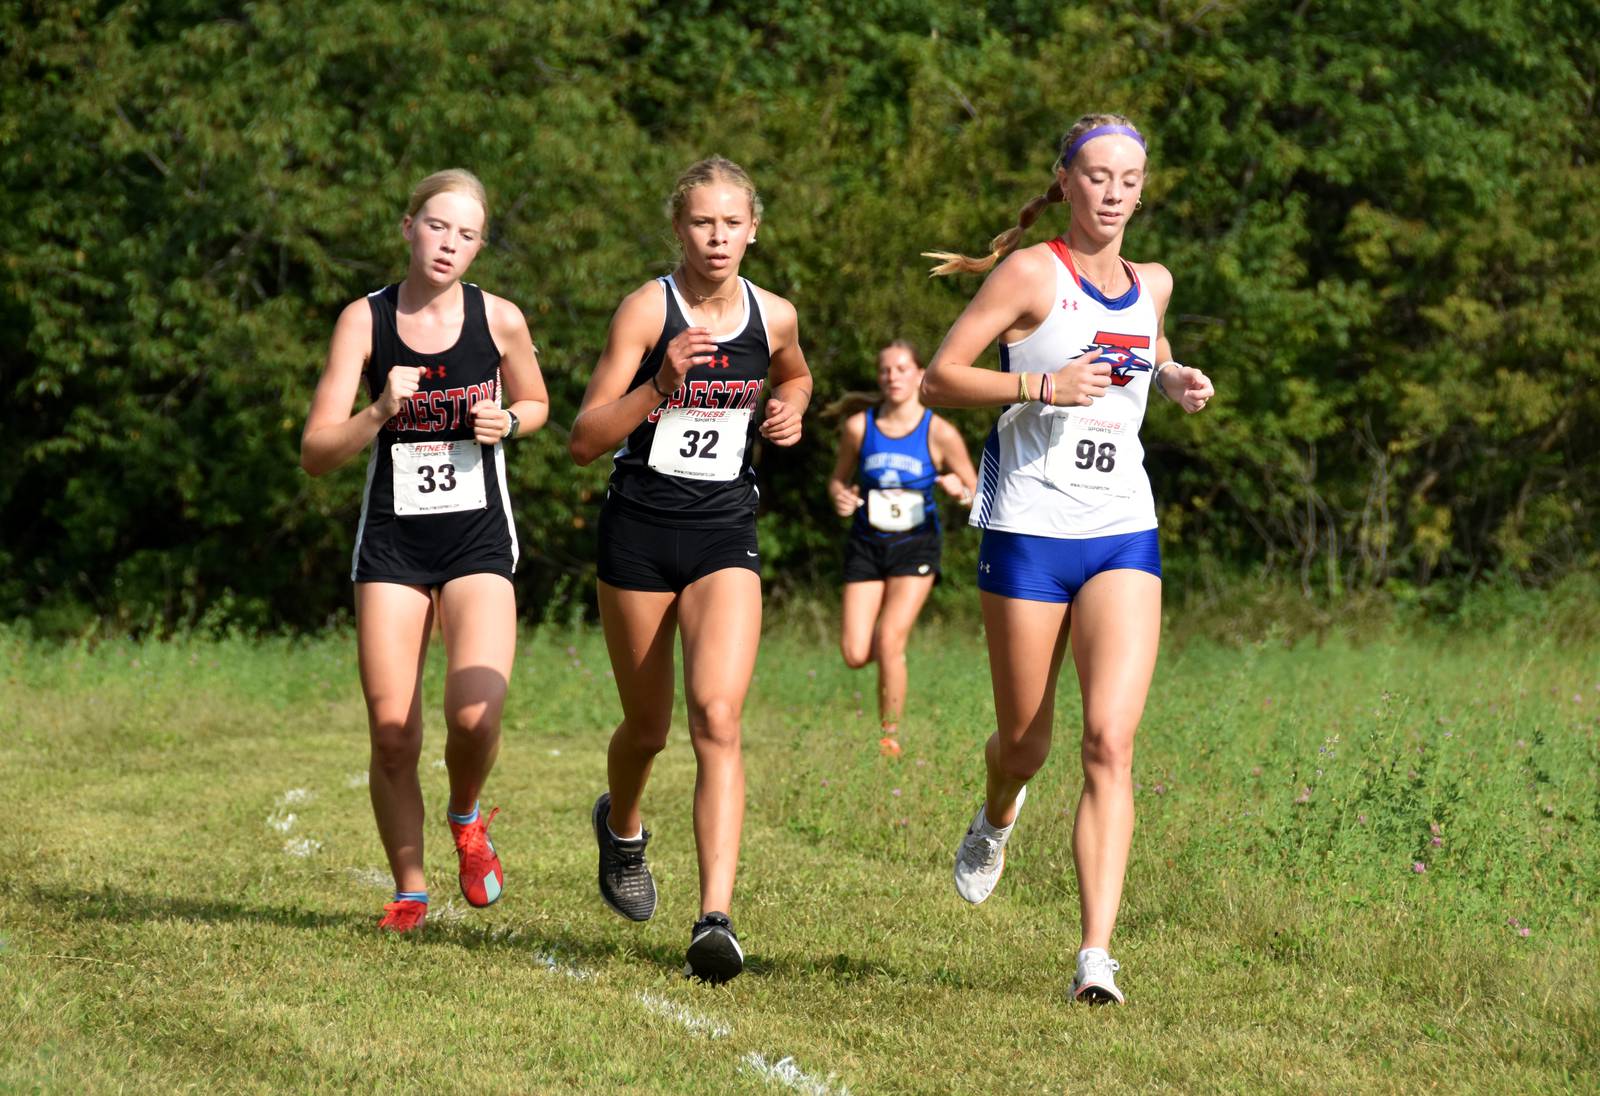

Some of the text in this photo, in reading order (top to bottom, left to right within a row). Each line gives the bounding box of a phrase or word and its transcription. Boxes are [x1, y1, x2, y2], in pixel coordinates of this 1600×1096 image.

[686, 409, 727, 418] FITNESS
[1079, 417, 1121, 430] FITNESS
[415, 442, 455, 453] FITNESS
[679, 430, 719, 459] 32
[1075, 439, 1117, 473] 98
[417, 464, 457, 494] 33
[890, 503, 902, 518] 5
